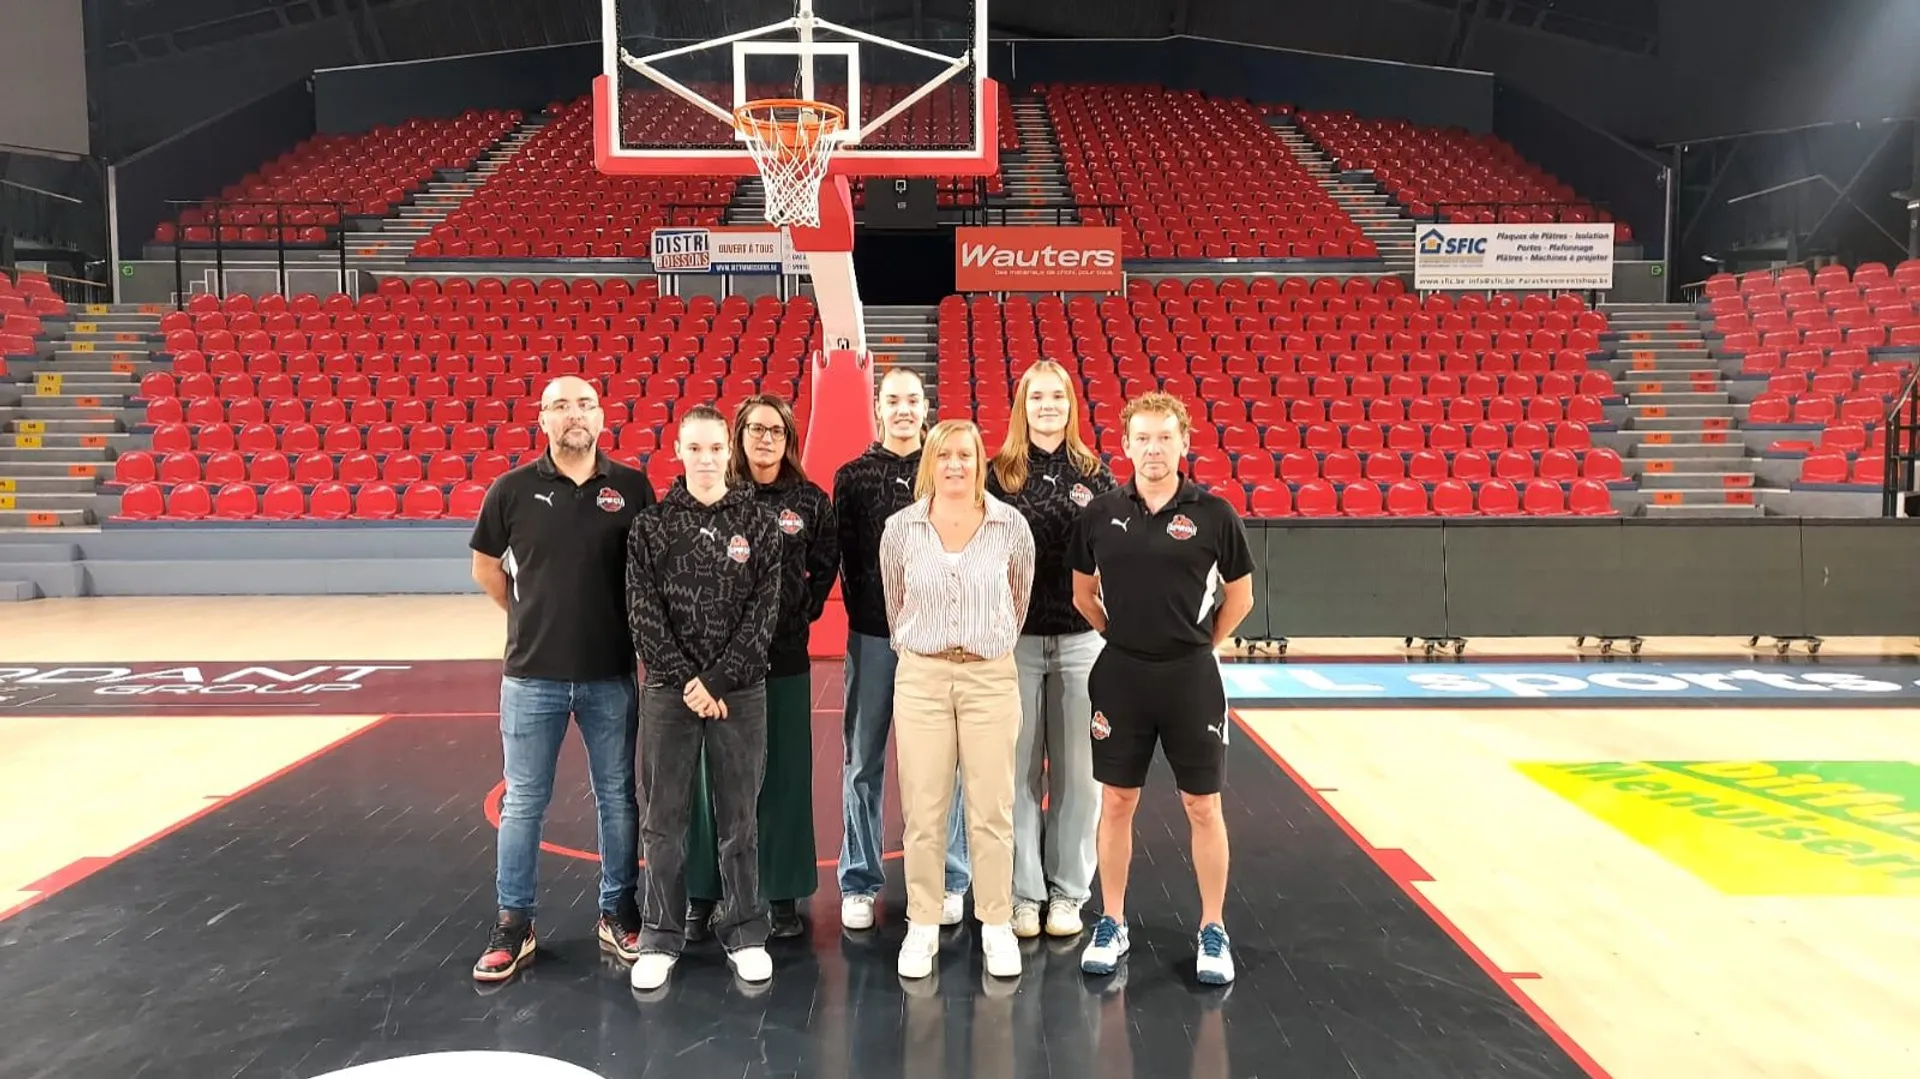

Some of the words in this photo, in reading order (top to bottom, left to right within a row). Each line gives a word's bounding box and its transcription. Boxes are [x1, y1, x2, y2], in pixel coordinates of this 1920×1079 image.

[1497, 232, 1527, 242] Plaques
[1528, 232, 1539, 240] de
[1541, 232, 1567, 240] Plâtres
[1575, 232, 1609, 240] Isolation
[656, 234, 709, 255] DISTRI
[718, 243, 748, 254] OUVERT
[755, 243, 774, 254] TOUS
[1444, 237, 1488, 255] SFIC
[1517, 244, 1542, 252] Portes
[1549, 244, 1593, 253] Plafonnage
[961, 242, 1115, 268] Wauters
[1496, 254, 1523, 262] Plâtres
[1530, 254, 1567, 262] Machines
[1576, 254, 1608, 263] projeter
[1419, 277, 1465, 285] www.sfic.be
[1469, 277, 1515, 285] info@sfic.be
[94, 683, 363, 695] GROUP
[1406, 668, 1902, 698] sports
[1680, 761, 1920, 836] Diffu
